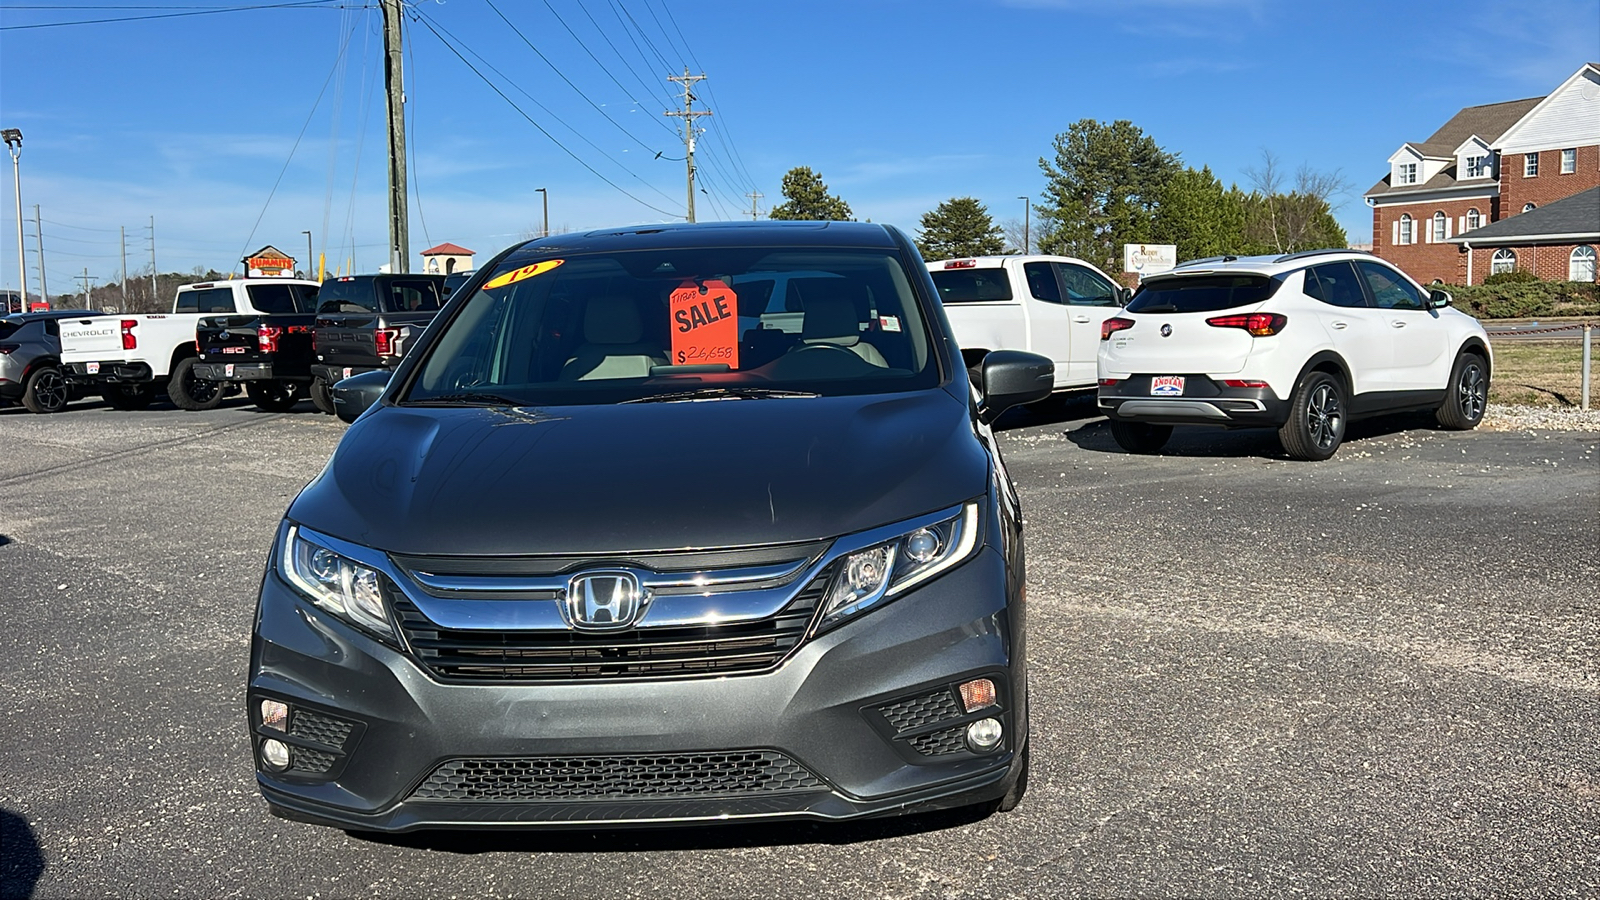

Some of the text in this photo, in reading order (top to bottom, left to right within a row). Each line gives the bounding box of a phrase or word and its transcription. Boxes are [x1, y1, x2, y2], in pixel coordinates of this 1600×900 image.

[250, 257, 293, 269] SUMMITS
[509, 264, 539, 283] 19
[675, 295, 732, 333] SALE
[62, 328, 116, 338] CHEVROLET
